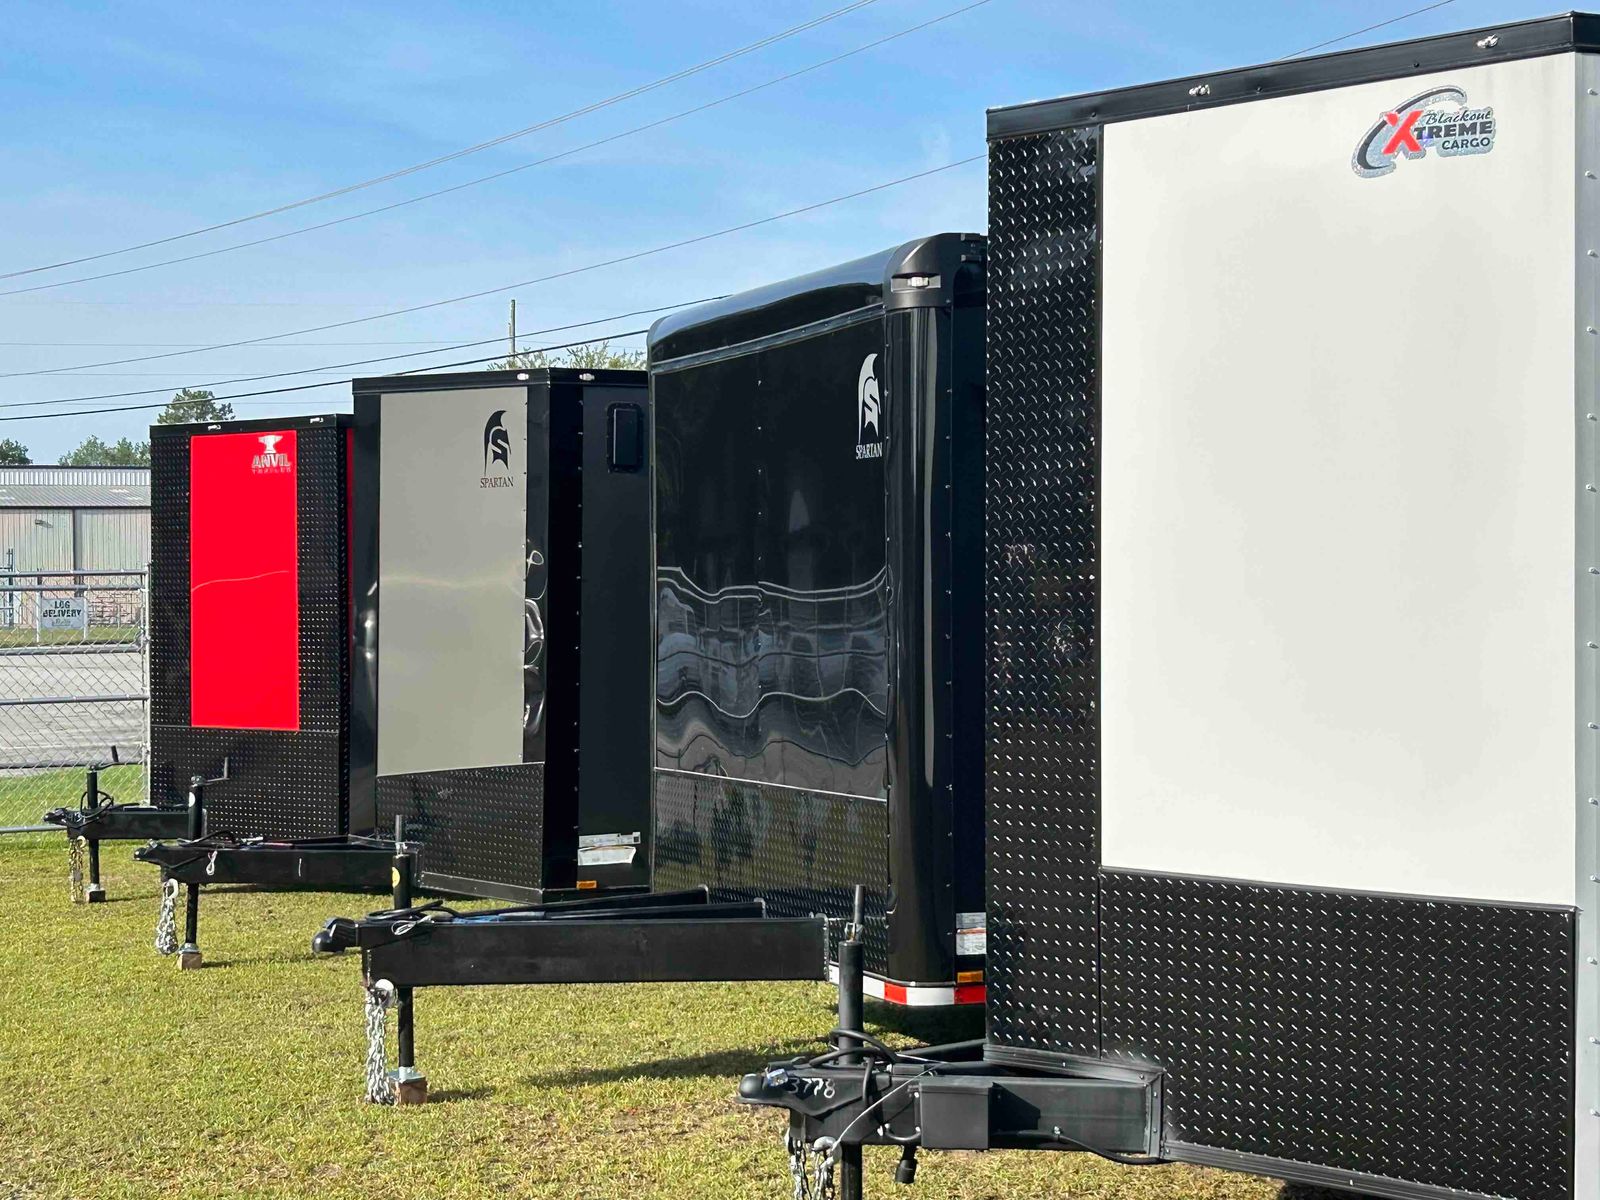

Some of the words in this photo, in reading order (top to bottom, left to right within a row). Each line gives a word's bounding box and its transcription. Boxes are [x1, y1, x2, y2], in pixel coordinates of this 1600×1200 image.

[1425, 109, 1491, 126] Blackout
[1441, 136, 1491, 150] CARGO
[855, 442, 883, 459] SPARTAN
[252, 453, 291, 469] ANVIL
[480, 477, 514, 488] SPARTAN
[54, 600, 71, 609] LOG
[43, 609, 82, 618] DELIVERY
[787, 1077, 836, 1099] 3778
